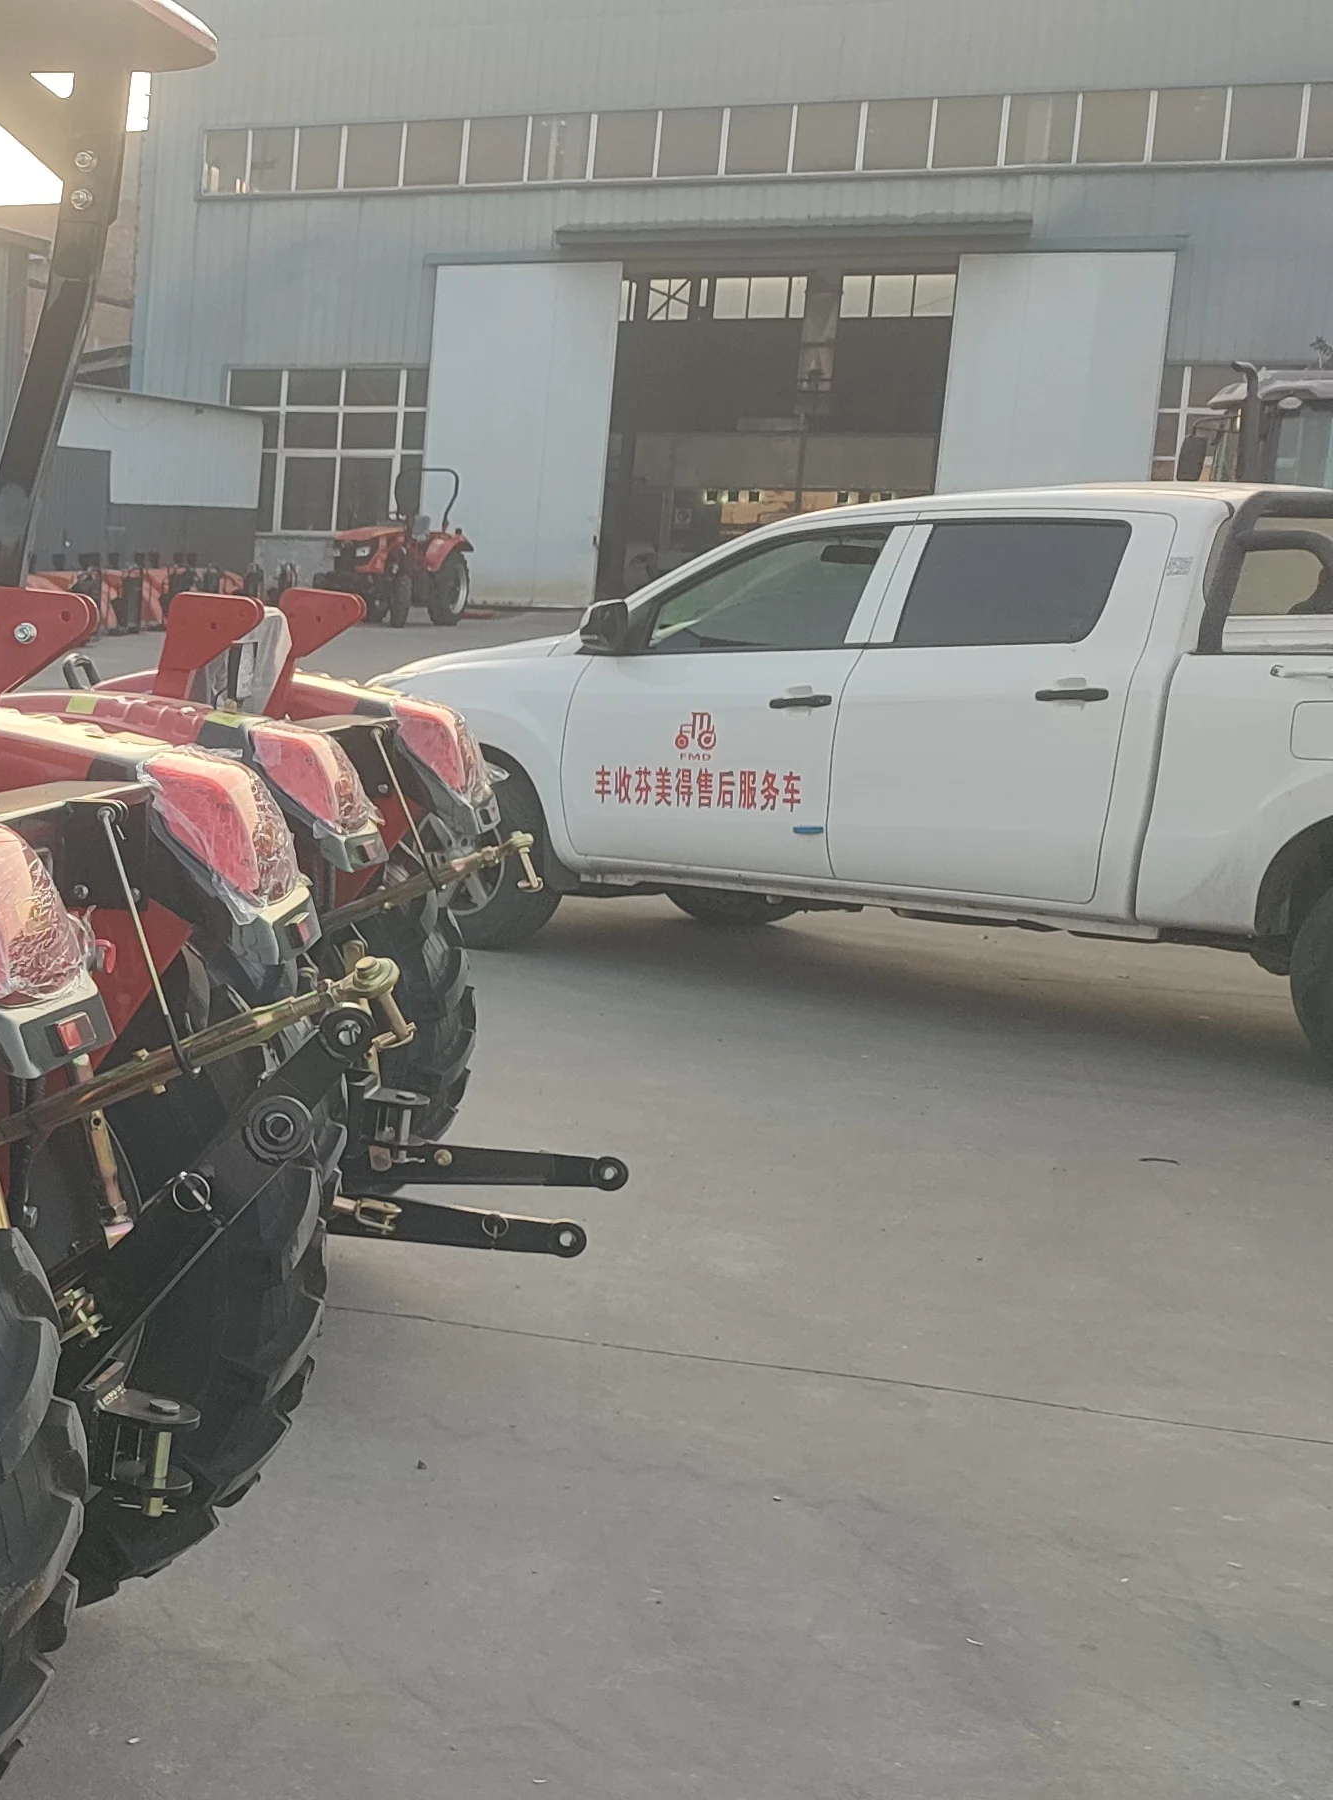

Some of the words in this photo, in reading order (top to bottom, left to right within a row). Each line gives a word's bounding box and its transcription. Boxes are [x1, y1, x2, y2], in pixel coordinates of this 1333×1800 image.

[680, 752, 712, 761] FMD
[594, 764, 802, 812] 丰收芬美得售后服务车
